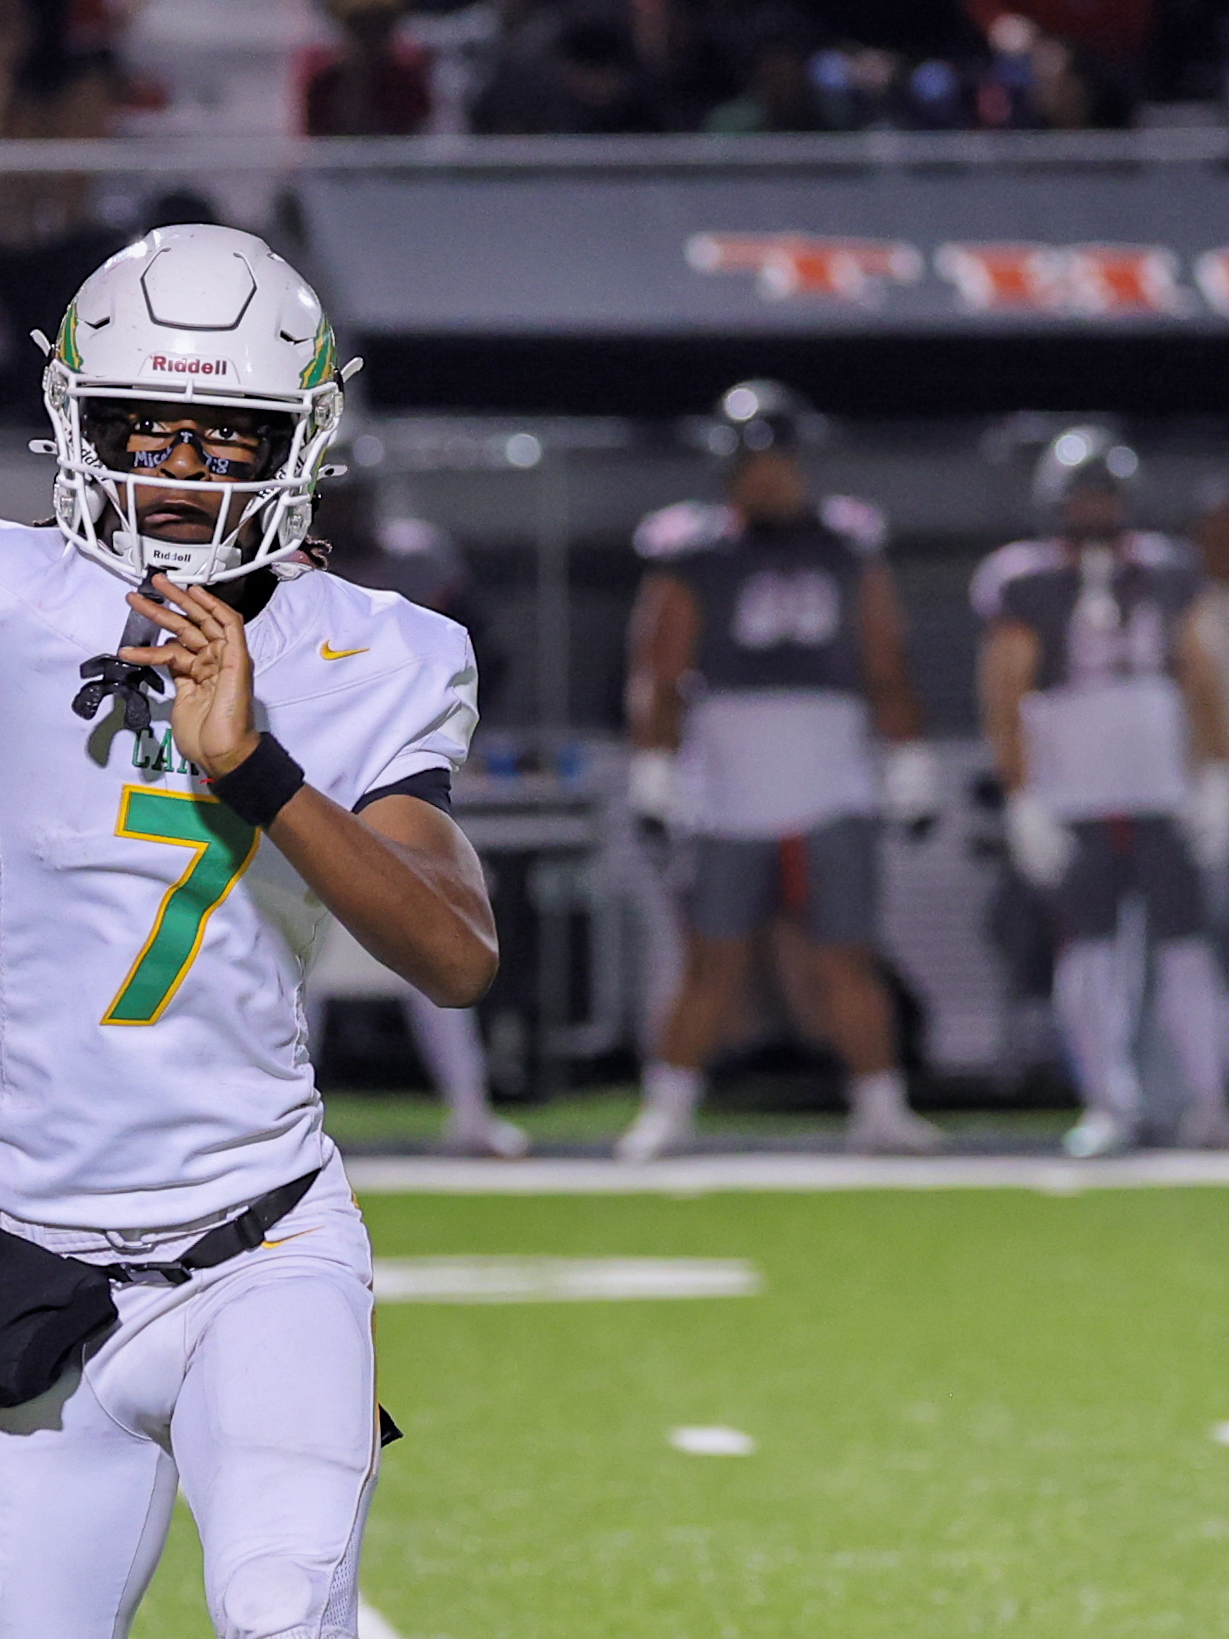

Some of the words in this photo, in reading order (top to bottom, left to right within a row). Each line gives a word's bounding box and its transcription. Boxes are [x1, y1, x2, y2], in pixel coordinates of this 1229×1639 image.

[152, 355, 227, 375] Riddell
[202, 450, 229, 474] 7:8
[153, 549, 192, 563] Riddell
[101, 784, 261, 1026] 7
